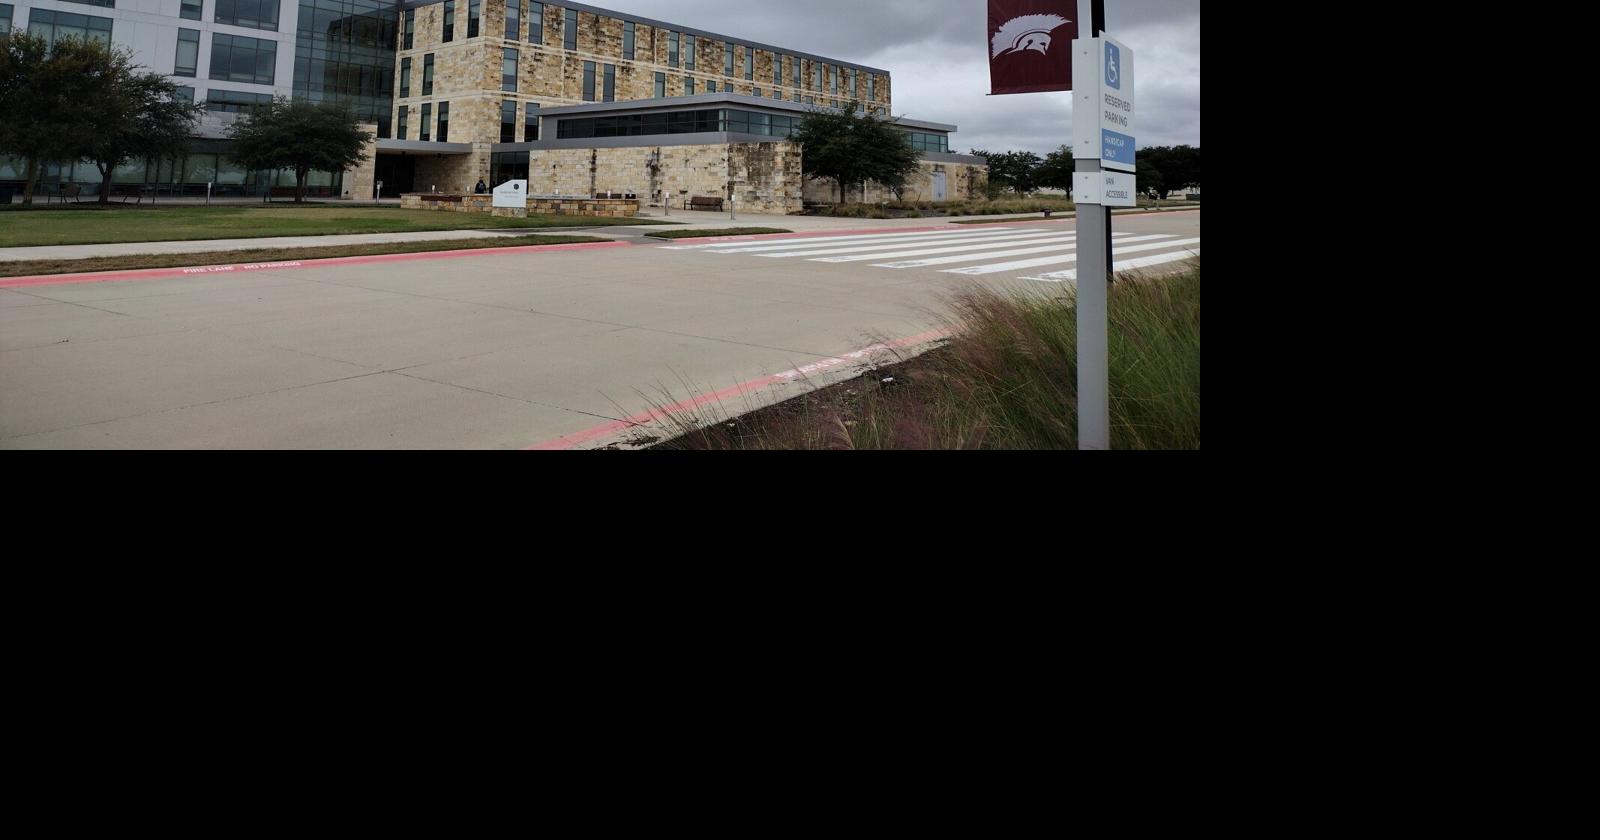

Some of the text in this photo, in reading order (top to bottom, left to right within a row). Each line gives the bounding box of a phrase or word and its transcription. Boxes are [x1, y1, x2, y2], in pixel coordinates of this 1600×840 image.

[1104, 93, 1131, 112] RESERVED
[1104, 110, 1128, 127] PARKING
[1105, 177, 1115, 185] VAN
[1105, 190, 1128, 199] ACCESSIBLE
